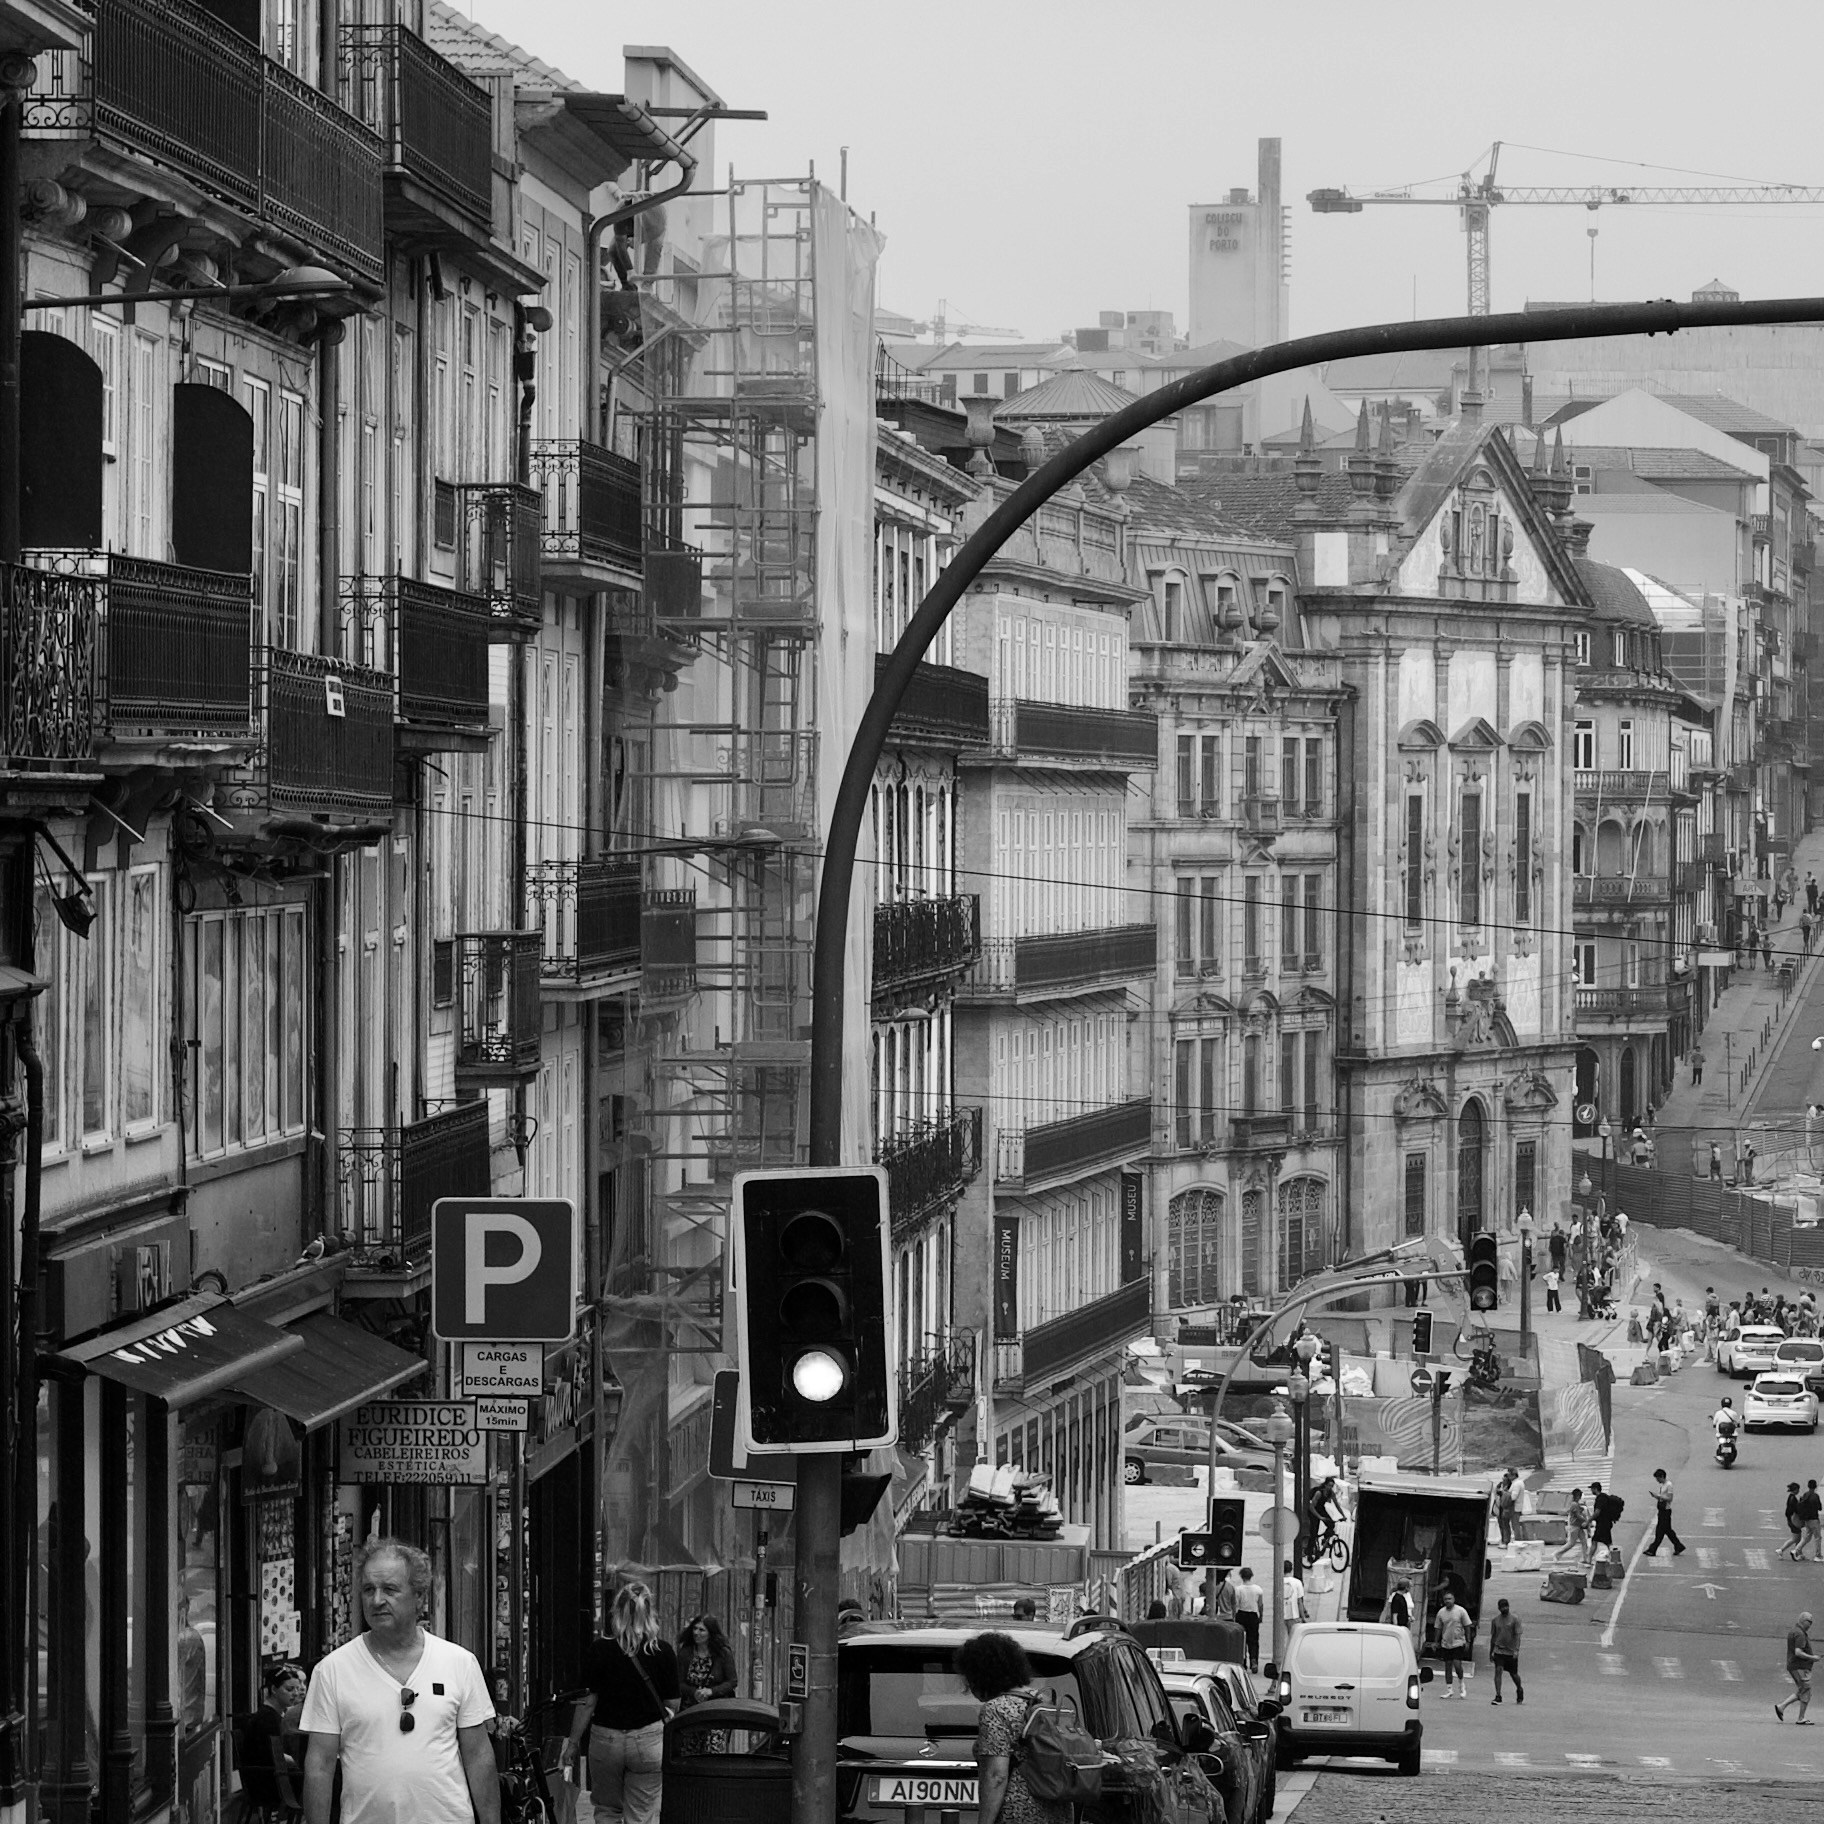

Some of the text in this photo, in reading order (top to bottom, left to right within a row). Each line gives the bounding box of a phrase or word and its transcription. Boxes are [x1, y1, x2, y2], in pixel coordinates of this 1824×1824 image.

[1127, 1184, 1137, 1221] MUSEU
[1000, 1229, 1012, 1280] MUSEUM
[465, 1213, 542, 1324] P
[477, 1351, 527, 1362] CARGAS
[500, 1365, 507, 1375] E
[465, 1376, 539, 1387] DESCARGAS
[356, 1407, 467, 1426] EURIDICE
[486, 1417, 518, 1426] 15min
[348, 1428, 480, 1447] FIGUEIREDO
[354, 1447, 470, 1460] CABELEIREIROS
[751, 1488, 776, 1503] TÁXIS
[890, 1780, 975, 1801] AI90NN
